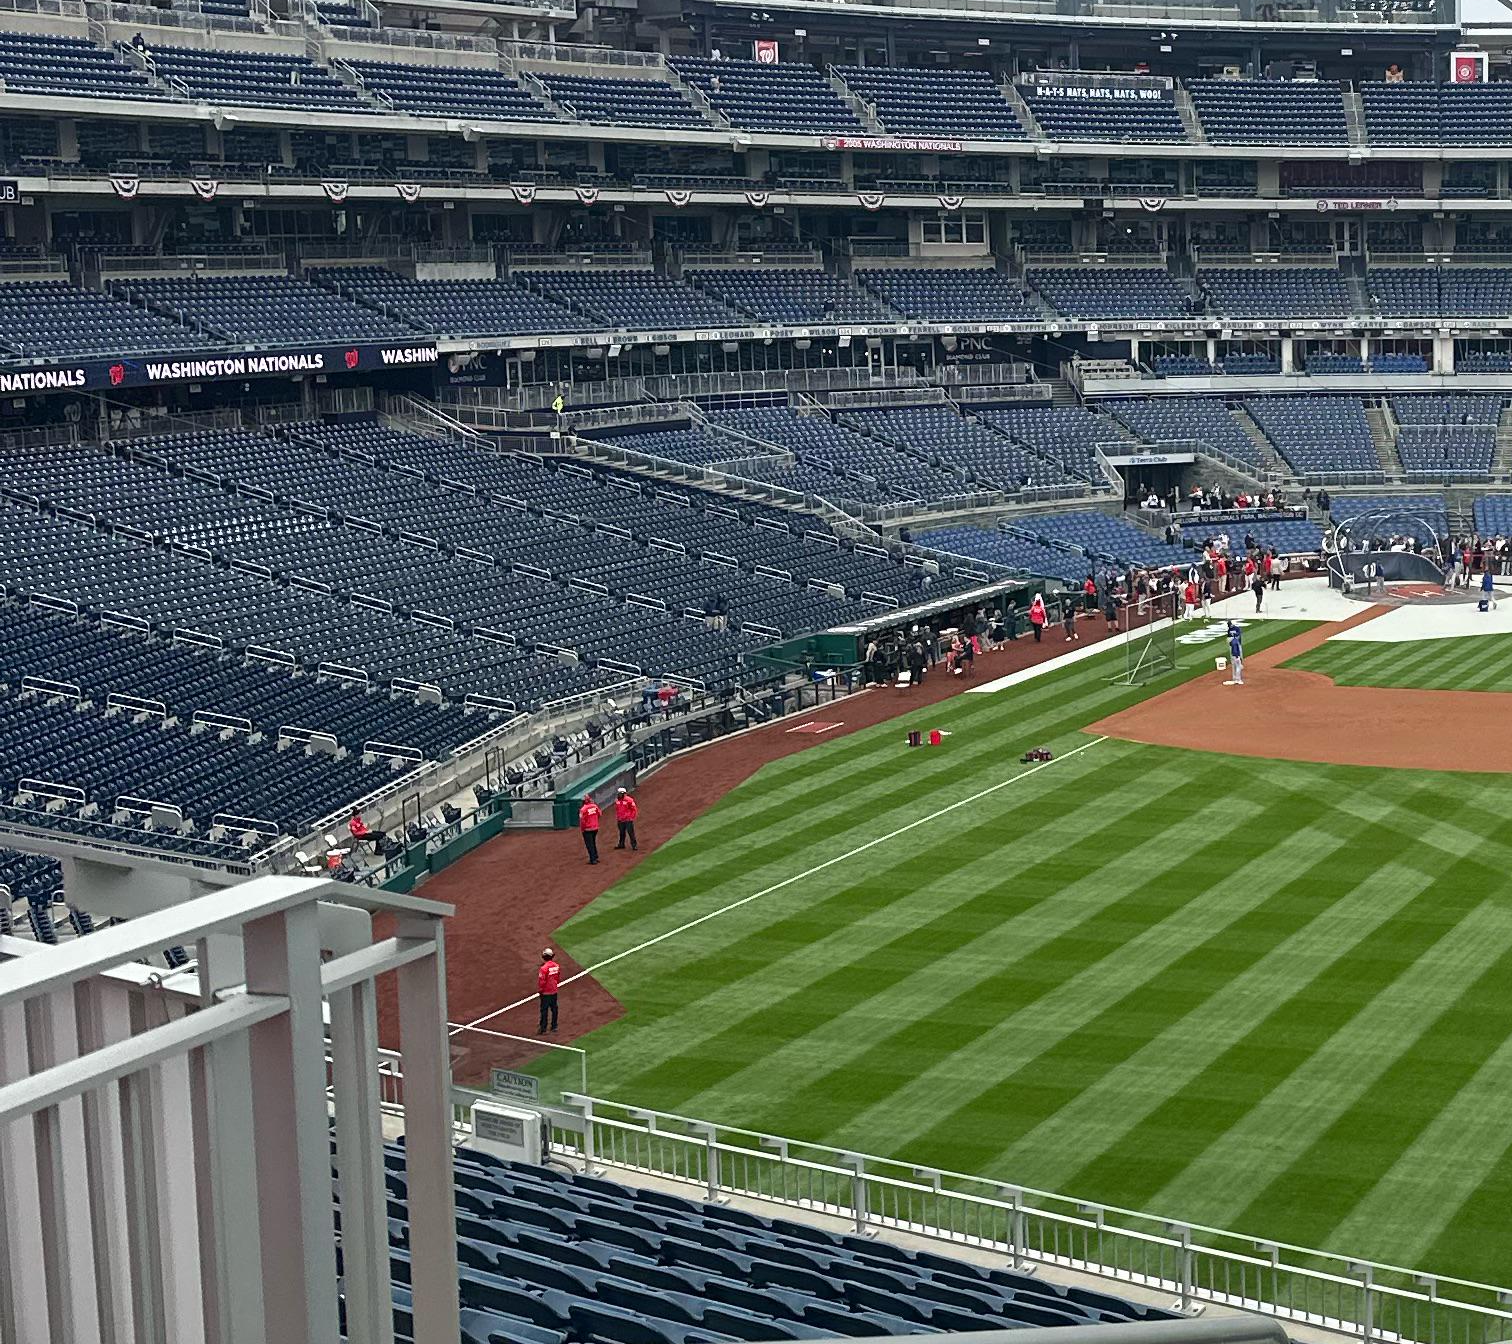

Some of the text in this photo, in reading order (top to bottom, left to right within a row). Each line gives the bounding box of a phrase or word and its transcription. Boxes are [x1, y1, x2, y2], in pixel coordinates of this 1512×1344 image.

[863, 140, 918, 150] WASHINGTON
[918, 141, 962, 151] NATIONALS
[960, 337, 993, 351] PNC
[381, 347, 438, 364] WASHIN
[145, 353, 324, 381] WASHINGTON NATIONALS
[0, 369, 86, 392] NATIONALS
